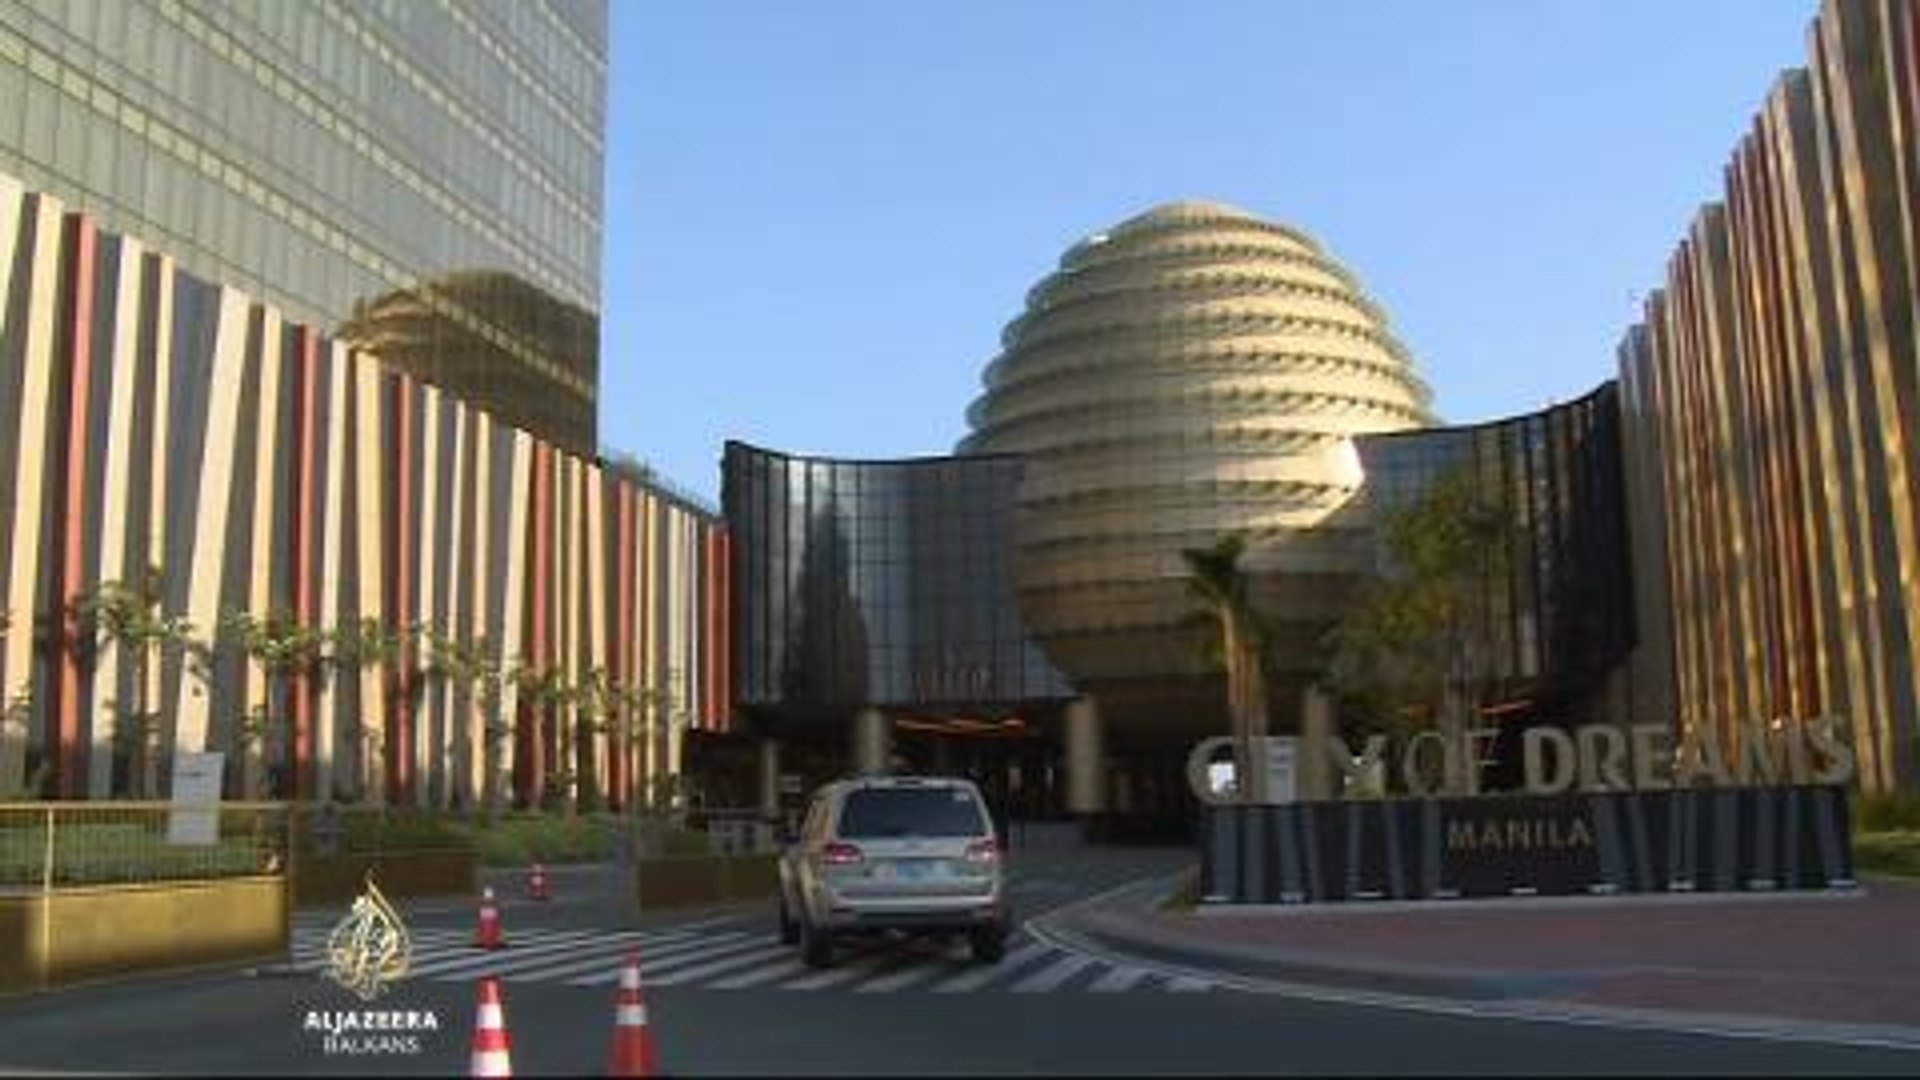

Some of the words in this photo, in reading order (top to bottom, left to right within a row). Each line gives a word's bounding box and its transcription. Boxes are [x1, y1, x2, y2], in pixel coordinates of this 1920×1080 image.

[1404, 729, 1501, 797] OF
[1522, 718, 1853, 795] DREAMS
[1447, 818, 1591, 850] MANILA
